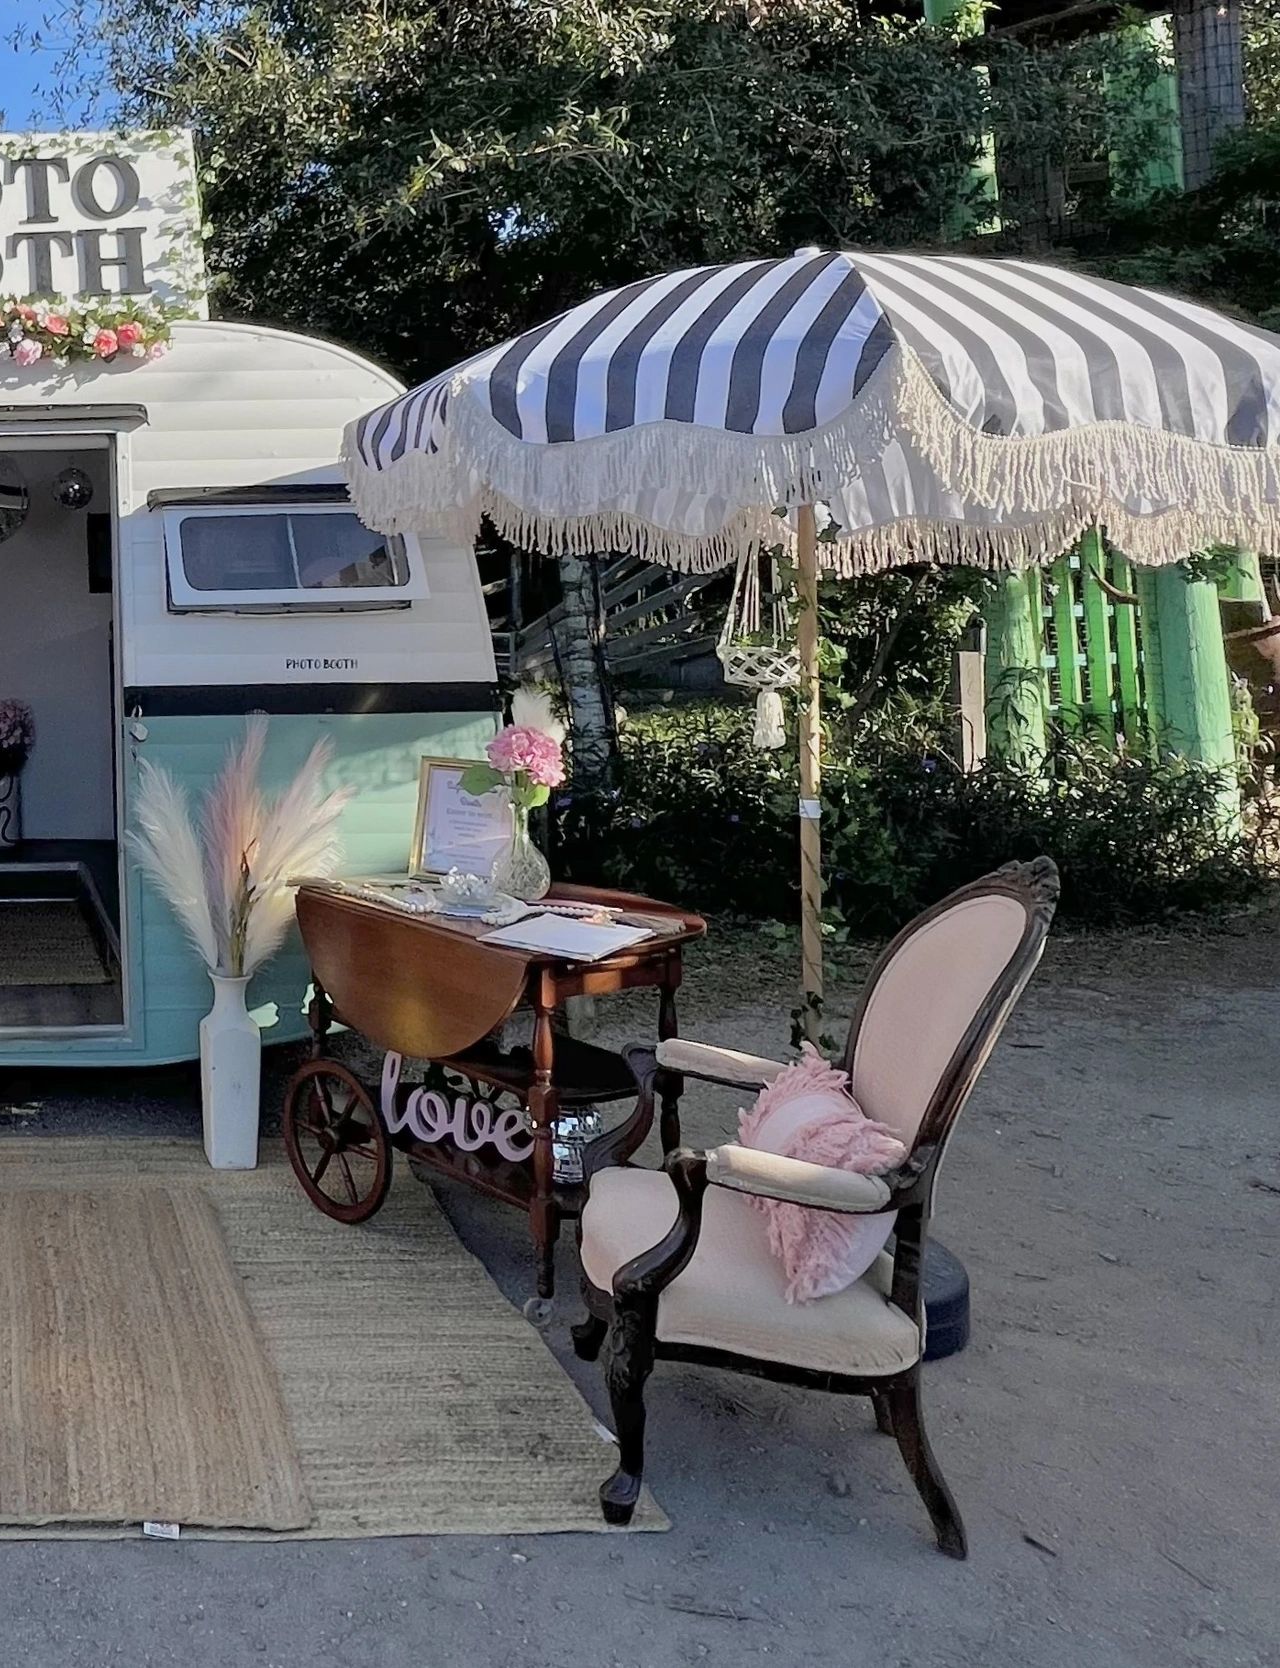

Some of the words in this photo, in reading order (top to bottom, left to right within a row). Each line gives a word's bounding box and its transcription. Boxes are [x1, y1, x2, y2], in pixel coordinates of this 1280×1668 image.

[285, 658, 321, 670] PHOTO
[323, 658, 359, 670] BOOTH
[380, 1049, 536, 1163] love
